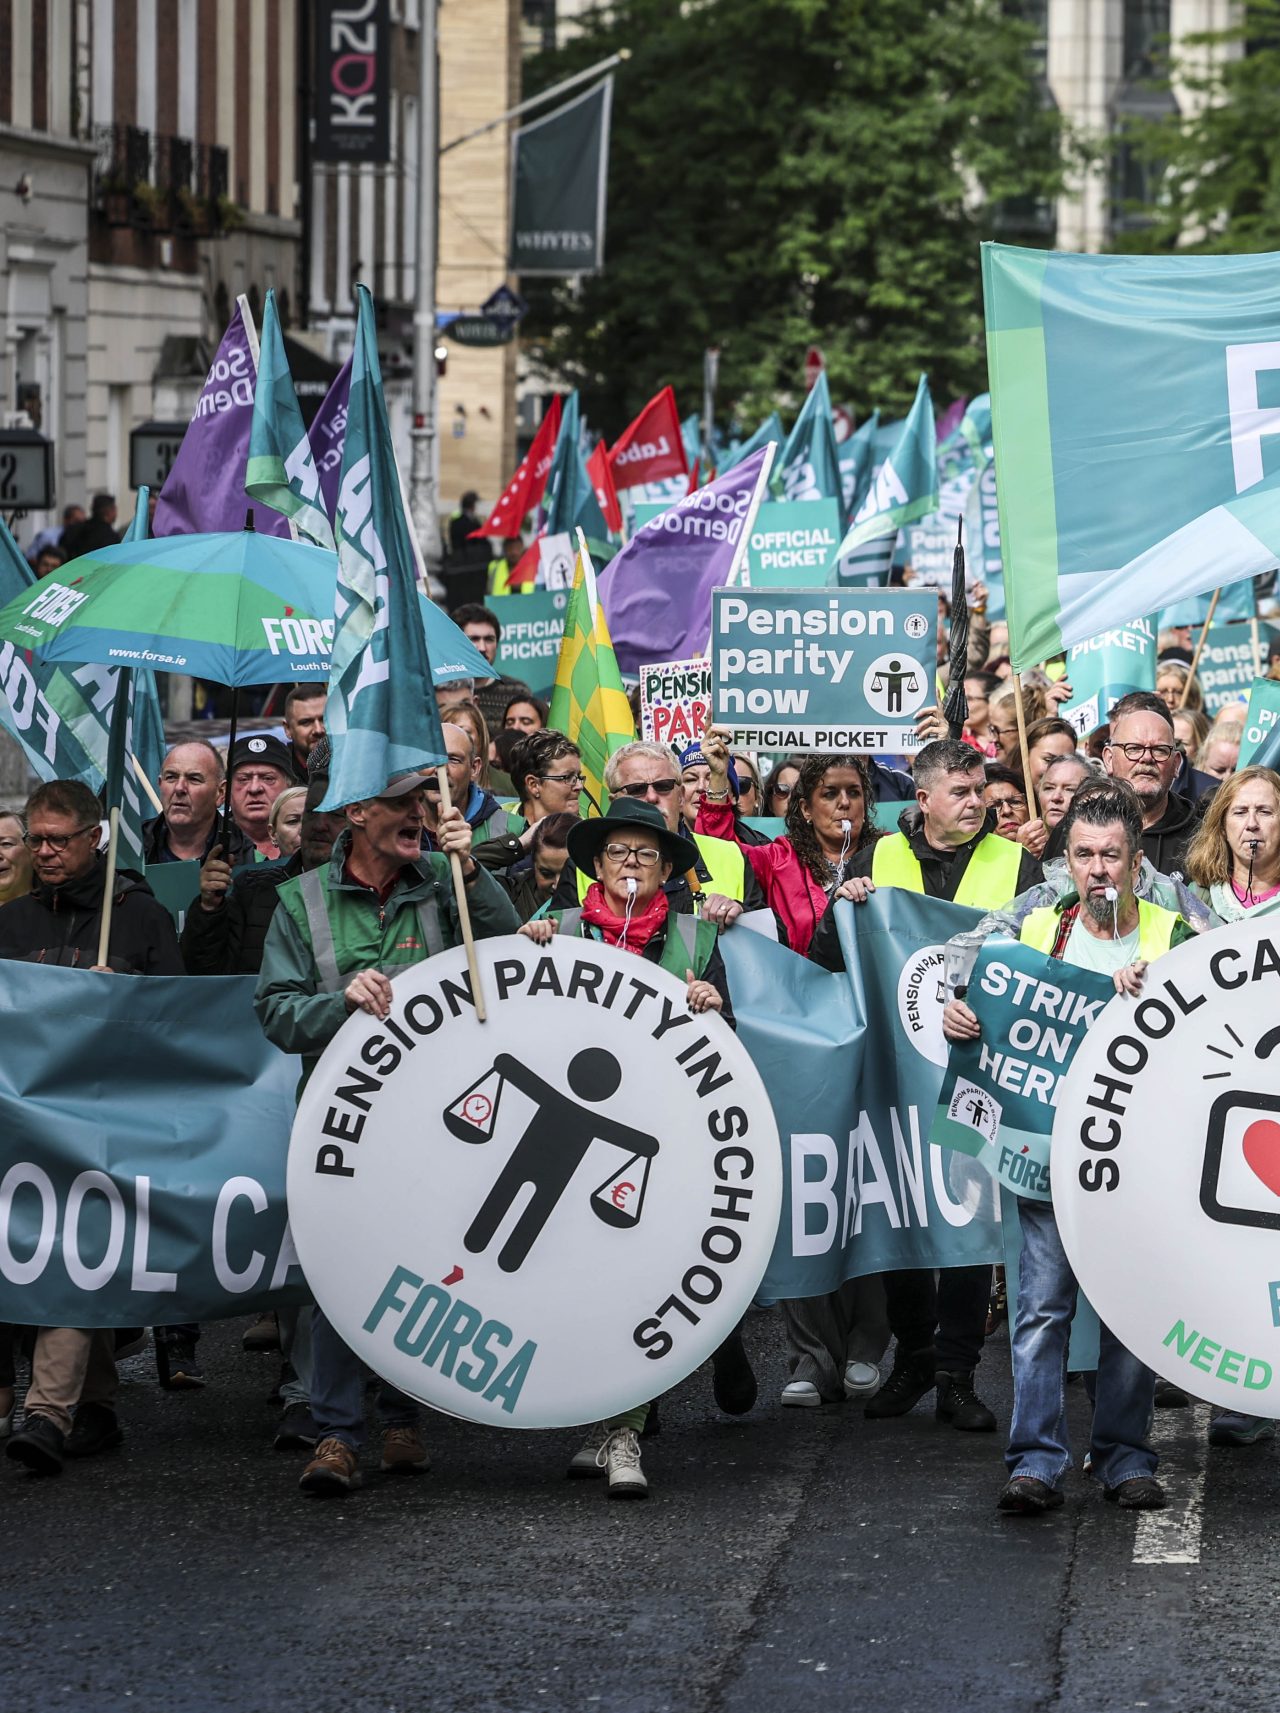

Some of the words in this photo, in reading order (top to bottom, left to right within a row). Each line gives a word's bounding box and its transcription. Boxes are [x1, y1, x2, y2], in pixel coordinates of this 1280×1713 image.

[751, 528, 835, 550] OFFICIAL
[760, 548, 828, 570] PICKET
[261, 606, 336, 656] FÓRS
[719, 598, 894, 636] Pension
[109, 647, 186, 666] www.forsa.ie
[291, 662, 321, 672] Louth
[719, 640, 854, 683] parity
[719, 687, 809, 714] now
[815, 731, 888, 748] PICKET
[494, 956, 695, 1041] PARITY
[906, 961, 928, 1032] PENSION
[980, 961, 1106, 1030] STRIK
[1008, 1018, 1073, 1064] ON
[315, 969, 474, 1178] PENSION
[675, 1034, 734, 1099] IN
[1078, 978, 1207, 1193] SCHOOL
[951, 1089, 967, 1117] PENSION
[966, 1088, 988, 1100] PARITY
[998, 1145, 1051, 1193] FÓRS
[632, 1104, 754, 1361] SCHOOLS
[362, 1263, 538, 1414] FÓRSA
[1162, 1319, 1273, 1392] NEED
